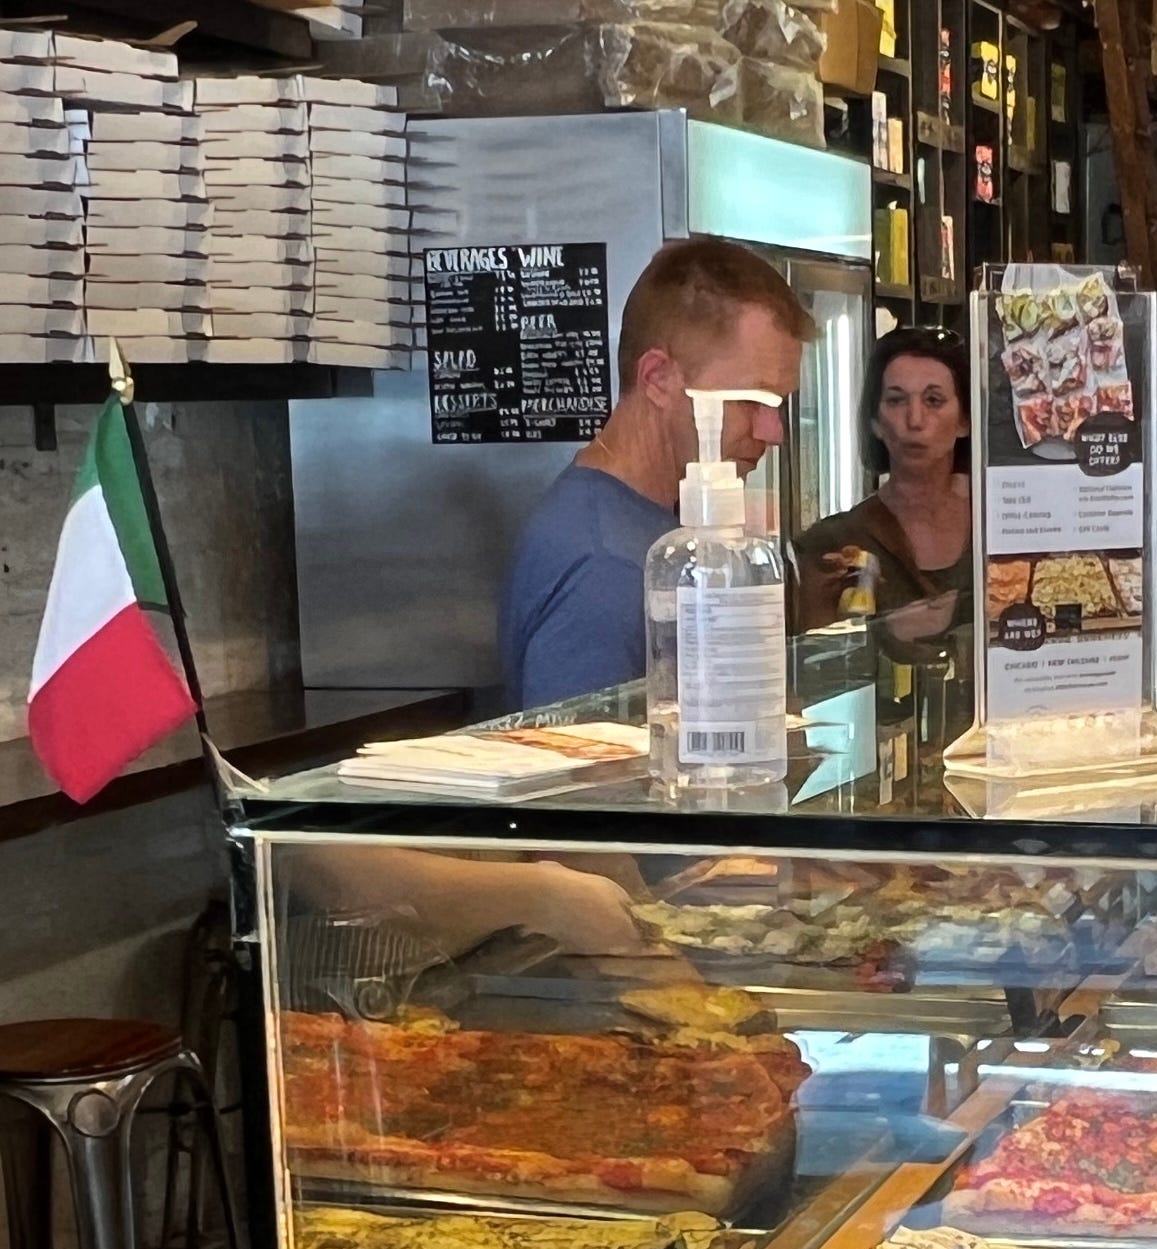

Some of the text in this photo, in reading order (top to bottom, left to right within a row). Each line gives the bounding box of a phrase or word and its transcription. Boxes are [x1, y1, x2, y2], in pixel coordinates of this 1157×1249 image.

[426, 247, 508, 273] BEVERAGES
[517, 246, 565, 268] WINE
[434, 392, 499, 415] DESSERTS
